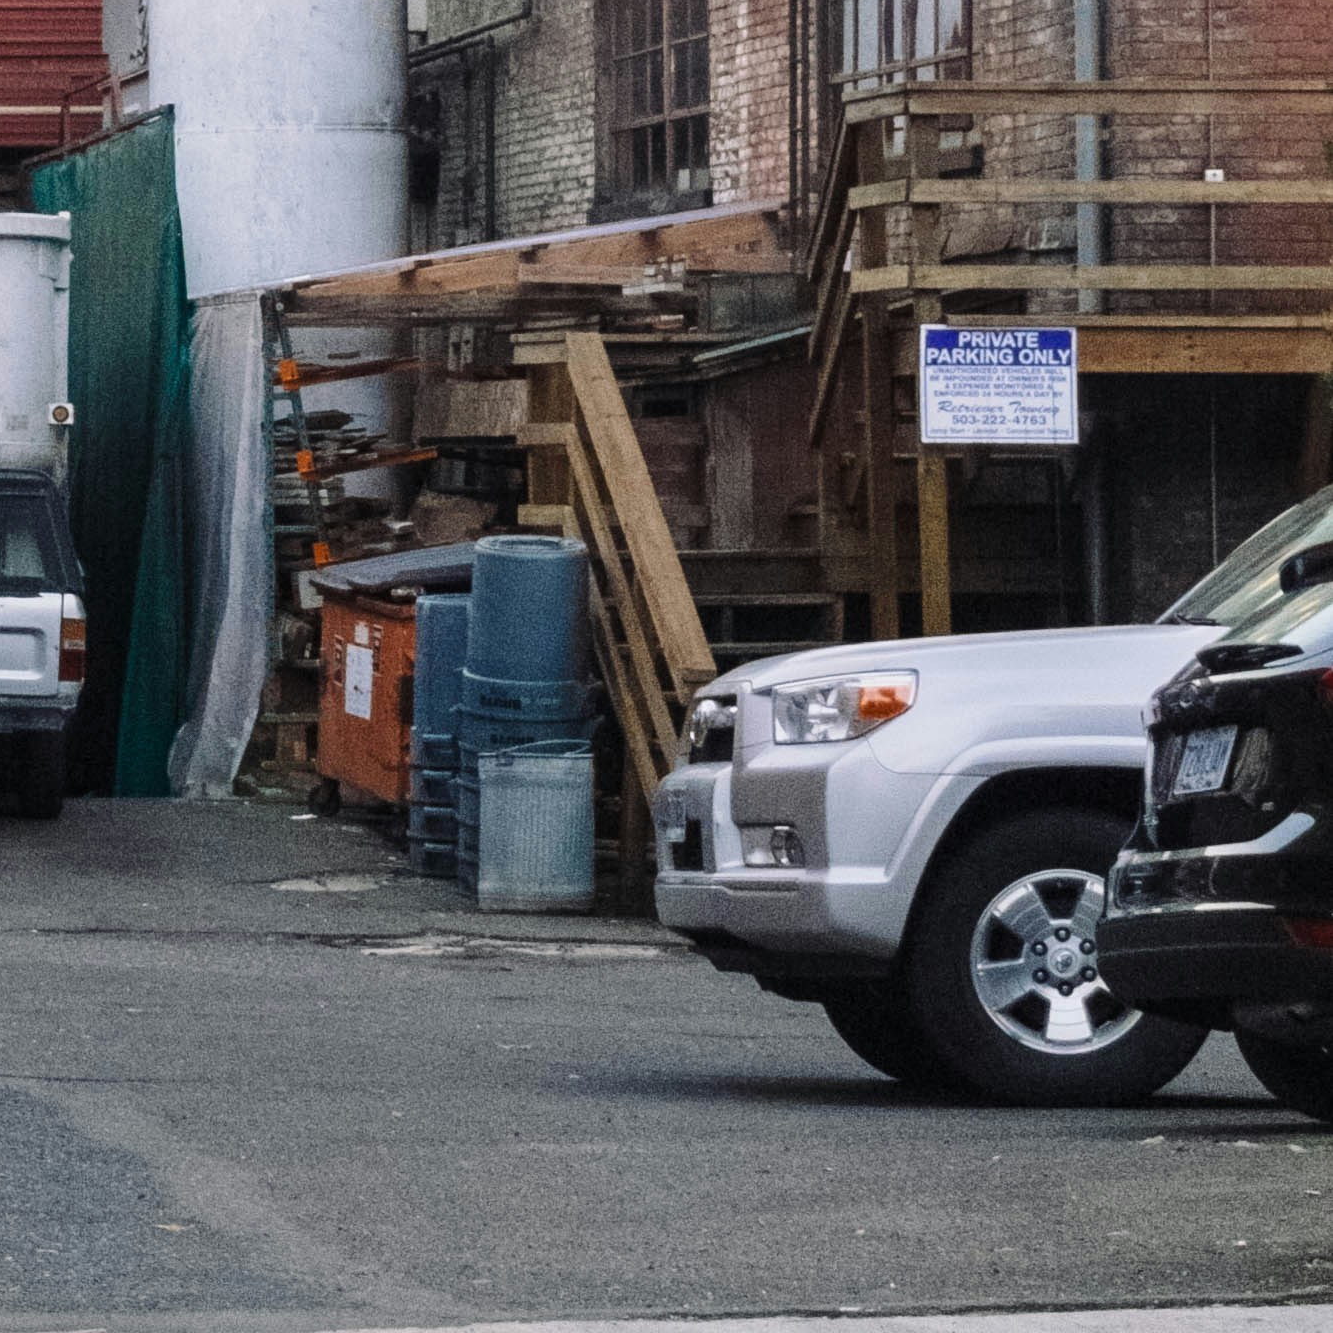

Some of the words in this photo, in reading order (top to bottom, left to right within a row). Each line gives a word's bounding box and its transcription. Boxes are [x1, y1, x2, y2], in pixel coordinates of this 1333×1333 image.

[958, 332, 1040, 348] PRIVATE
[927, 348, 1014, 364] PARKING
[1019, 349, 1071, 365] ONLY
[937, 400, 1004, 413] Retriever
[1008, 400, 1060, 415] Towing
[952, 415, 1047, 425] 503-222-4763
